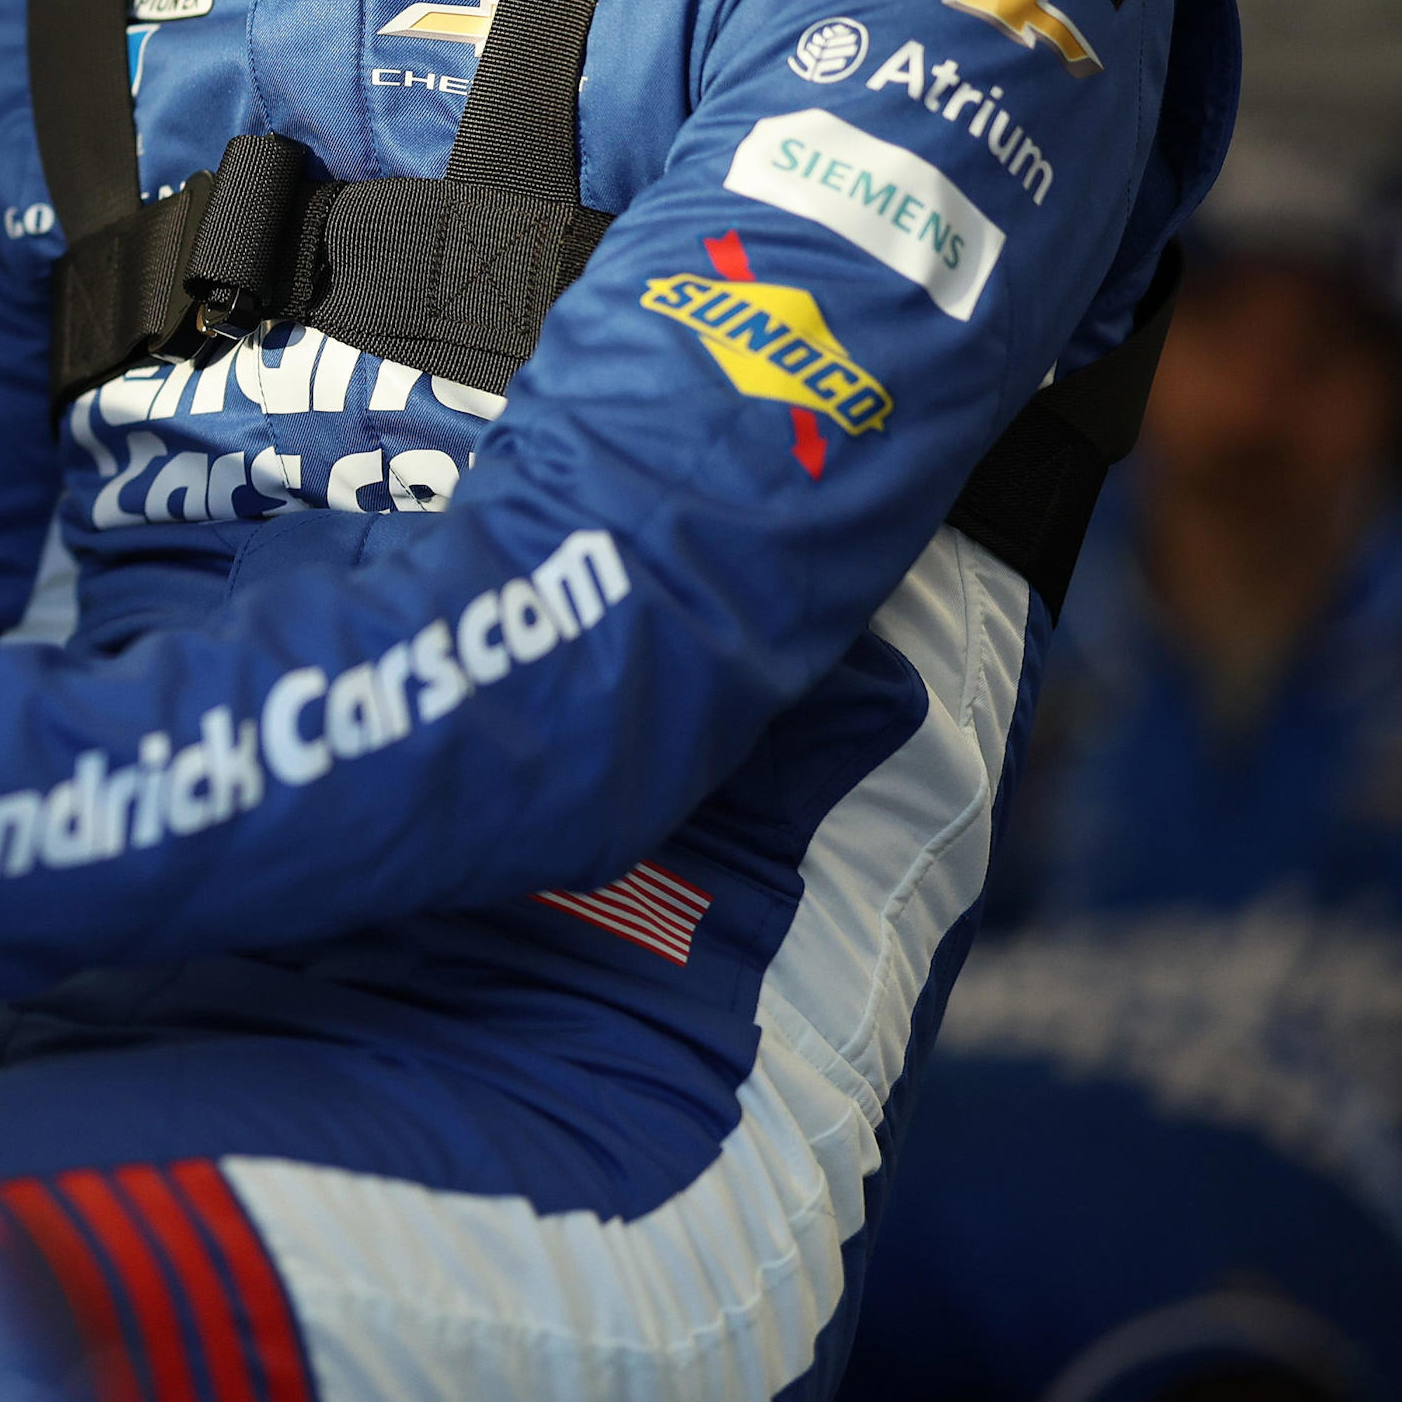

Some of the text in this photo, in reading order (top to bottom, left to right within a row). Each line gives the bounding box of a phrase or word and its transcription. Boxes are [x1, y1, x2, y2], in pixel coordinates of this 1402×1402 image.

[866, 39, 1056, 207] Atrium
[770, 137, 968, 272] SIEMENS
[658, 278, 889, 431] SUNOCO
